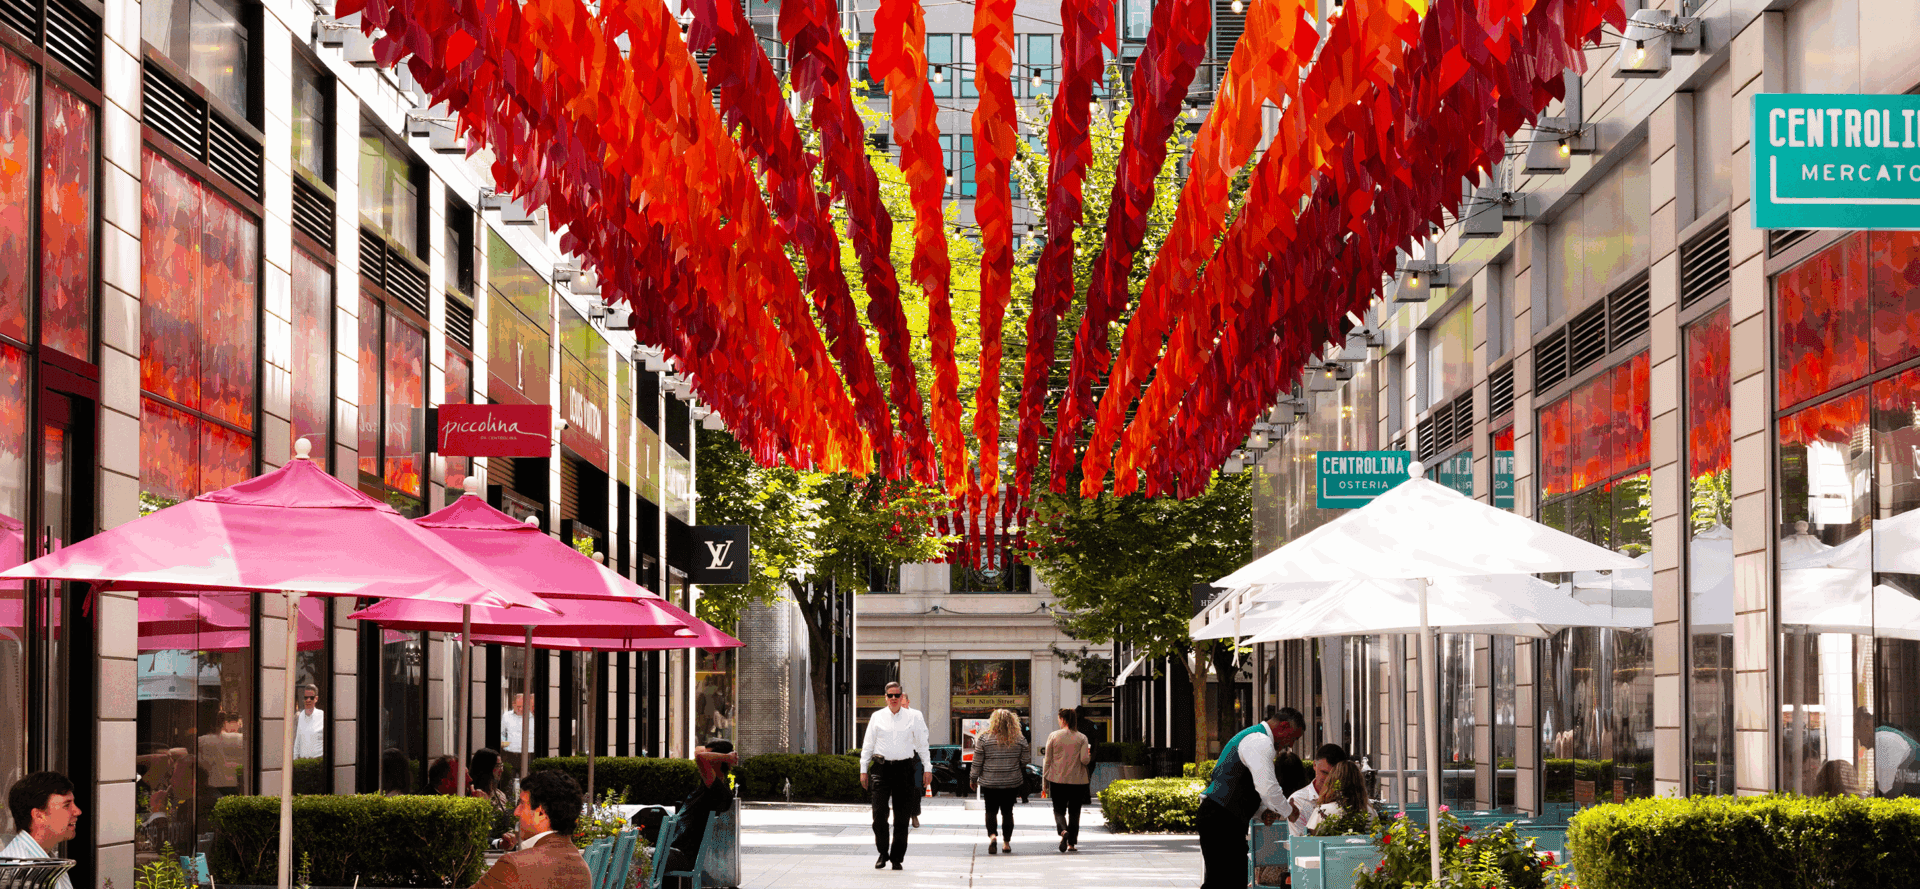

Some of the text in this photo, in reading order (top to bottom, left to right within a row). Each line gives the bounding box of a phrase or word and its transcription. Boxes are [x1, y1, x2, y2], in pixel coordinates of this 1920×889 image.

[1769, 108, 1920, 148] CENTROLI
[1801, 164, 1920, 182] MERCATO
[442, 411, 548, 449] piccolina
[1322, 456, 1405, 475] CENTROLINA
[1338, 480, 1389, 490] OSTERIA
